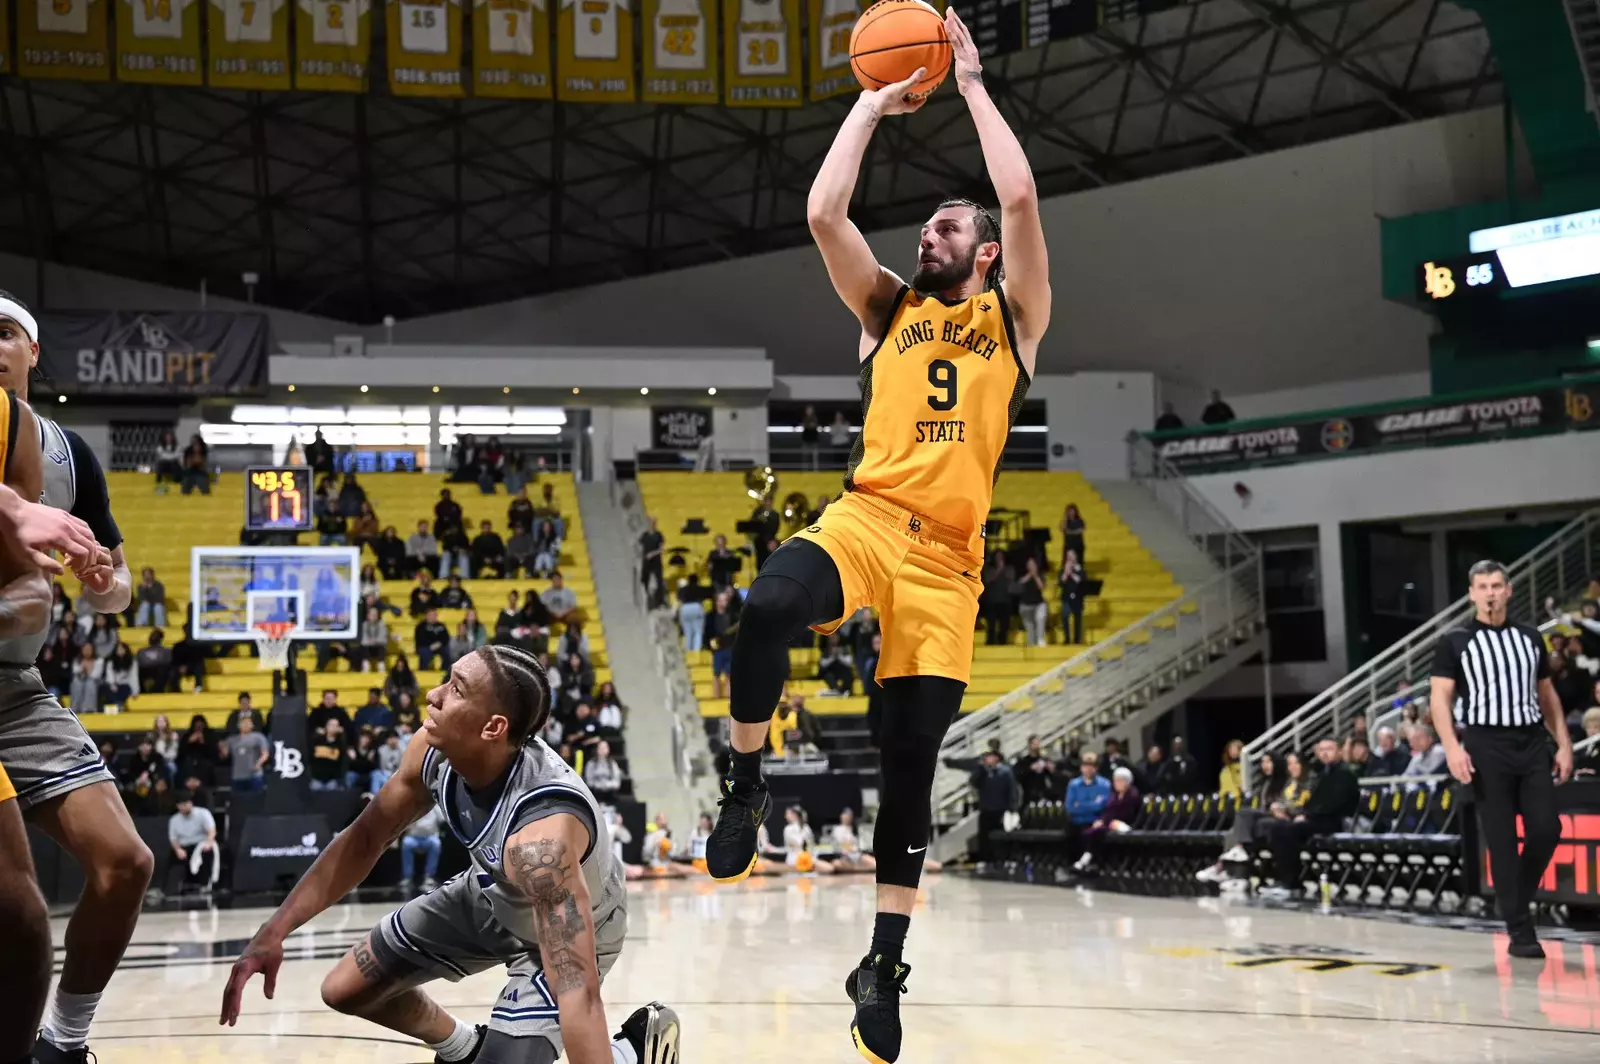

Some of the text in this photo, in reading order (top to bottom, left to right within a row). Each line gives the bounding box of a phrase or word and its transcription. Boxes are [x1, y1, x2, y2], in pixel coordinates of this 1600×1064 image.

[411, 10, 435, 28] 15
[503, 13, 518, 37] 7
[663, 28, 695, 55] 42
[748, 39, 779, 65] 20
[894, 319, 999, 361] LONG BEACH
[77, 349, 216, 385] SANDPIT
[927, 358, 958, 411] 9
[1468, 395, 1543, 421] TOYOTA
[1563, 388, 1594, 422] LB
[915, 420, 966, 443] STATE
[1237, 426, 1300, 450] TOYOTA
[252, 471, 295, 492] 43.5
[270, 489, 301, 523] 17
[908, 514, 922, 533] LB
[273, 740, 305, 779] LB
